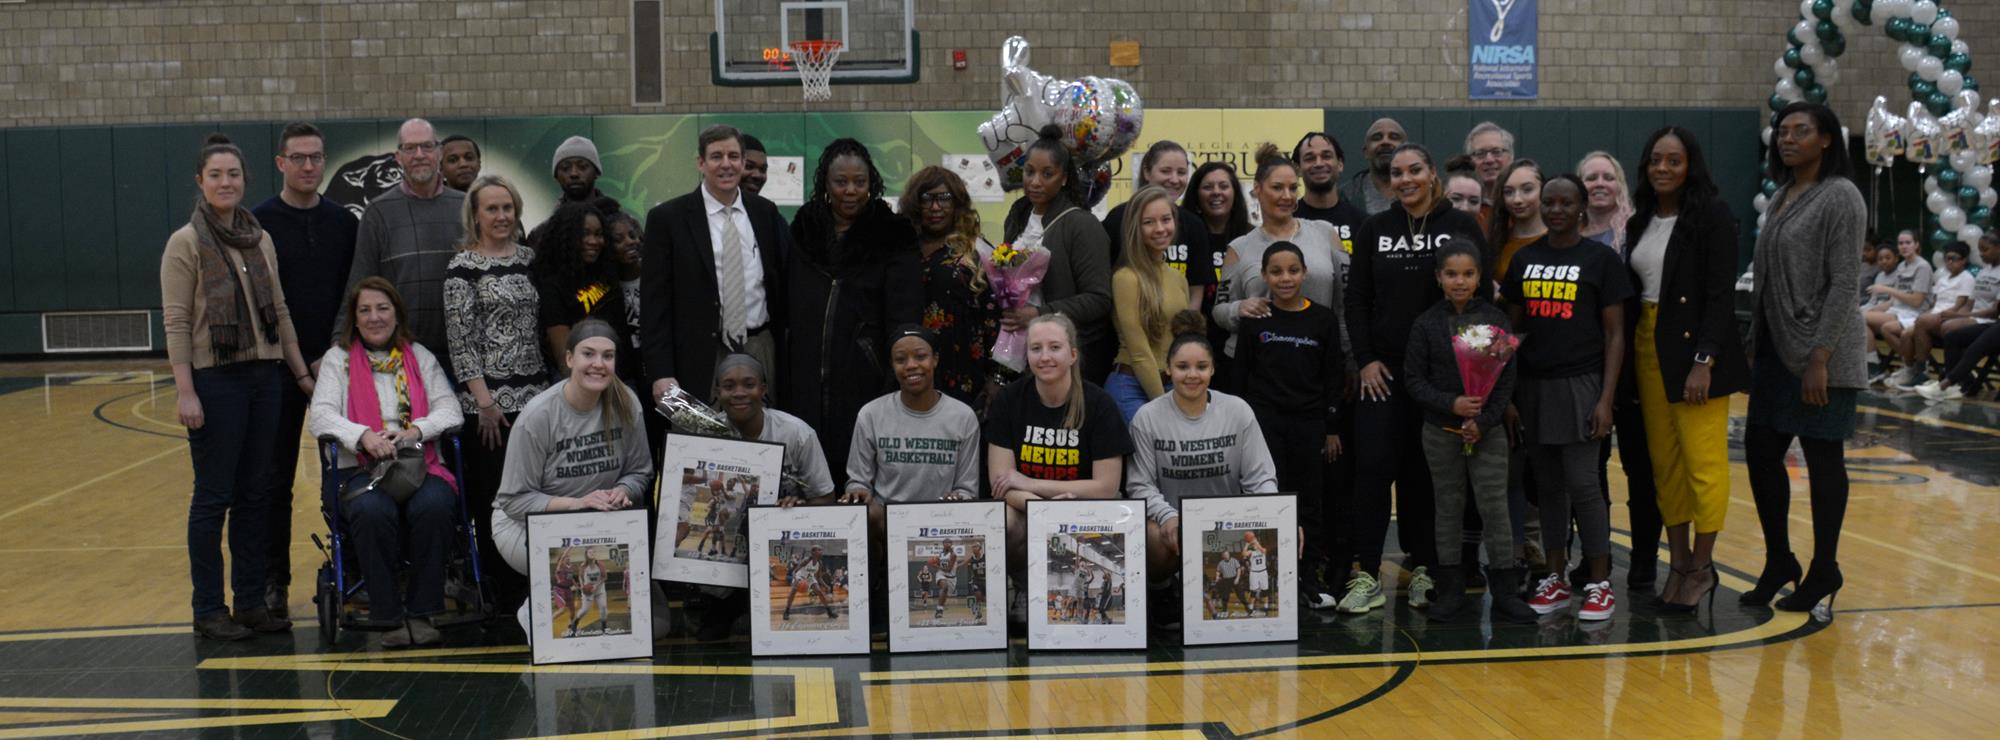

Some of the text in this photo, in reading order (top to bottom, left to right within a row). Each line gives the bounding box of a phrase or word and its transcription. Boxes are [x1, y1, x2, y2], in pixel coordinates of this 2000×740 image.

[1471, 45, 1535, 64] NIRSA
[1523, 264, 1581, 281] JESUS
[1527, 300, 1573, 320] TOPS
[878, 437, 900, 449] OLD
[1023, 425, 1080, 447] JESUS
[1154, 434, 1237, 452] OLD WESTBURY
[885, 451, 955, 465] BASKETBALL
[1020, 444, 1080, 465] NEVER
[1170, 451, 1225, 467] WOMEN'S
[556, 456, 620, 478] BASKETBALL
[716, 464, 751, 473] BASKETBALL
[1161, 464, 1231, 480] BASKETBALL
[582, 537, 616, 545] BASKETBALL
